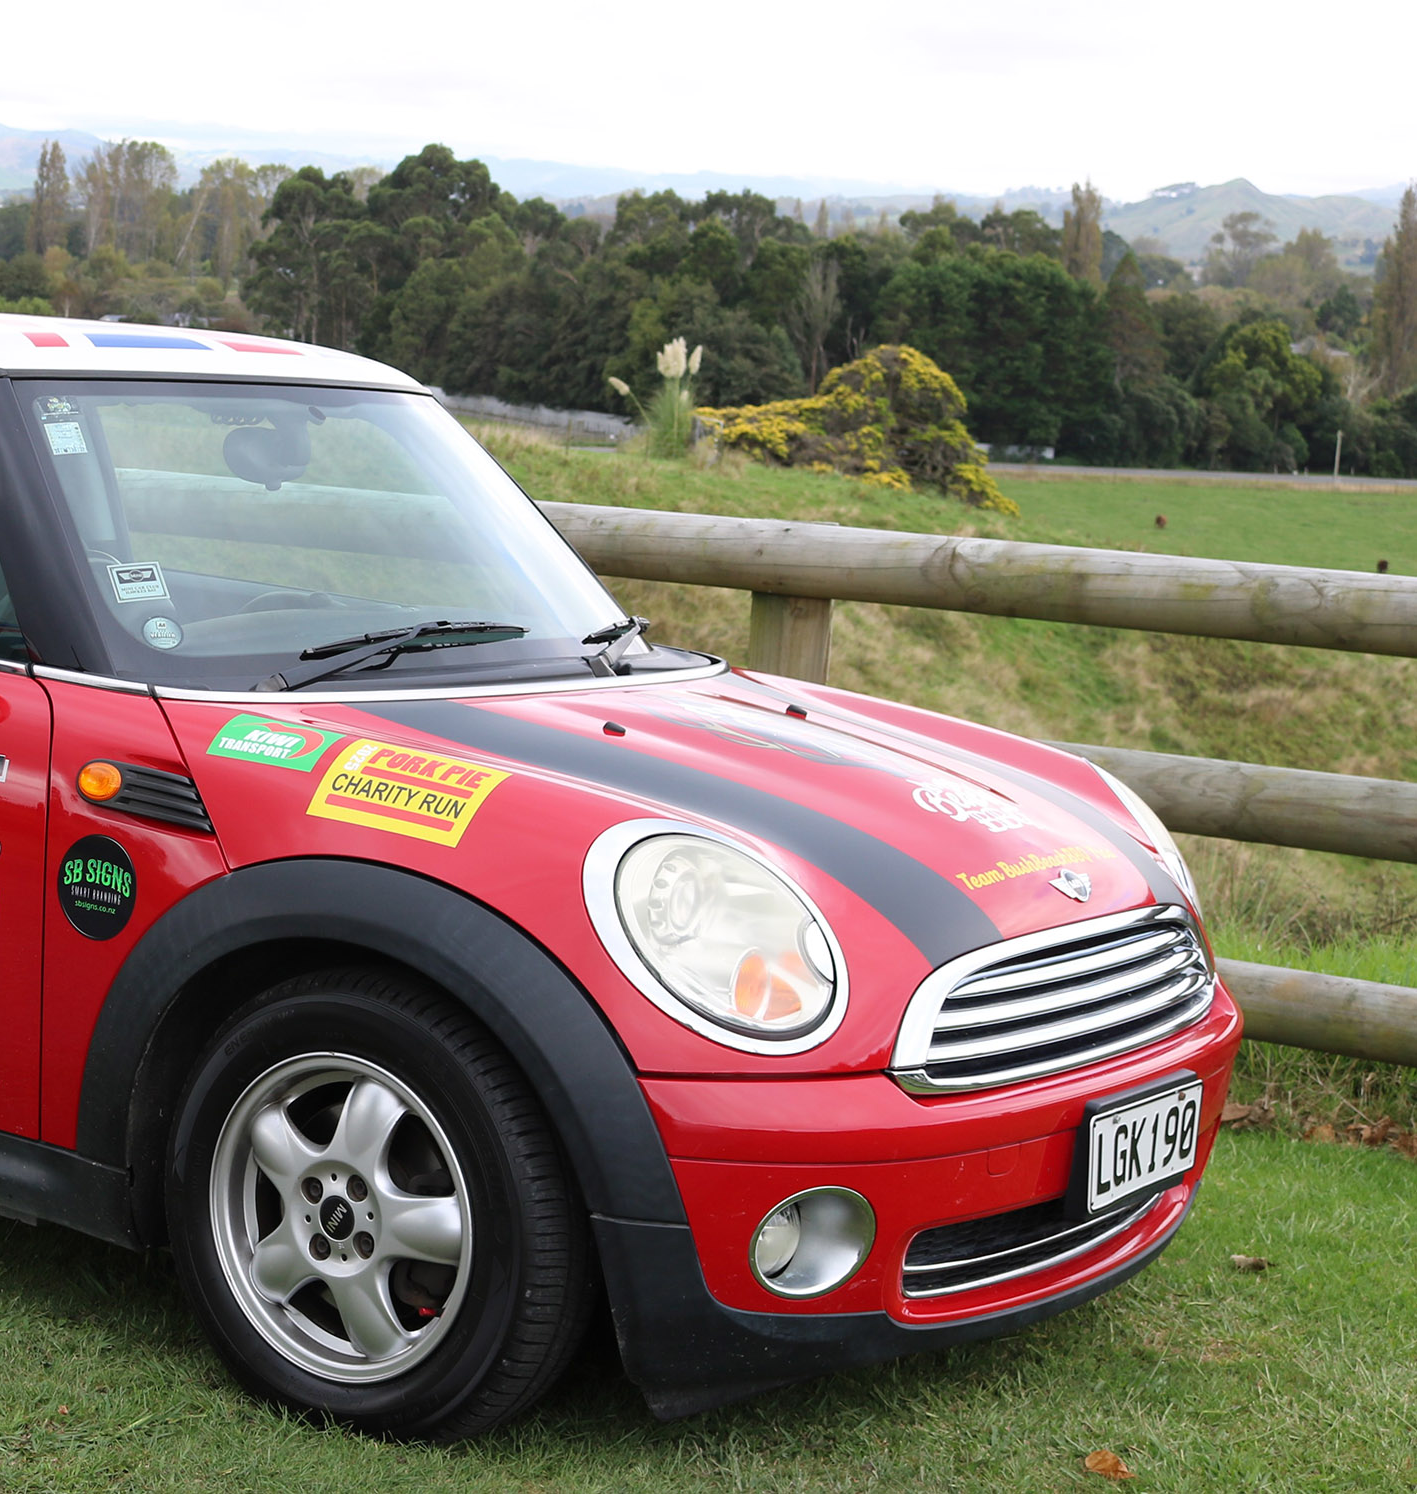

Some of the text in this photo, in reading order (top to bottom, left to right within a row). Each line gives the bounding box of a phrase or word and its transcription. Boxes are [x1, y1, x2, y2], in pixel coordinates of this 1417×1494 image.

[218, 737, 292, 760] TRANSPORT
[244, 729, 303, 748] KIWI
[343, 743, 379, 772] 2025
[367, 748, 493, 789] PORK PIE
[331, 772, 466, 819] CHARITY RUN
[63, 858, 132, 898] SB SIGNS
[956, 868, 1006, 890] Team
[71, 885, 121, 906] SMART BRANDING
[74, 900, 116, 915] sbsigns.co.nz
[1096, 1099, 1196, 1196] LGK190
[326, 1203, 347, 1233] MINI
